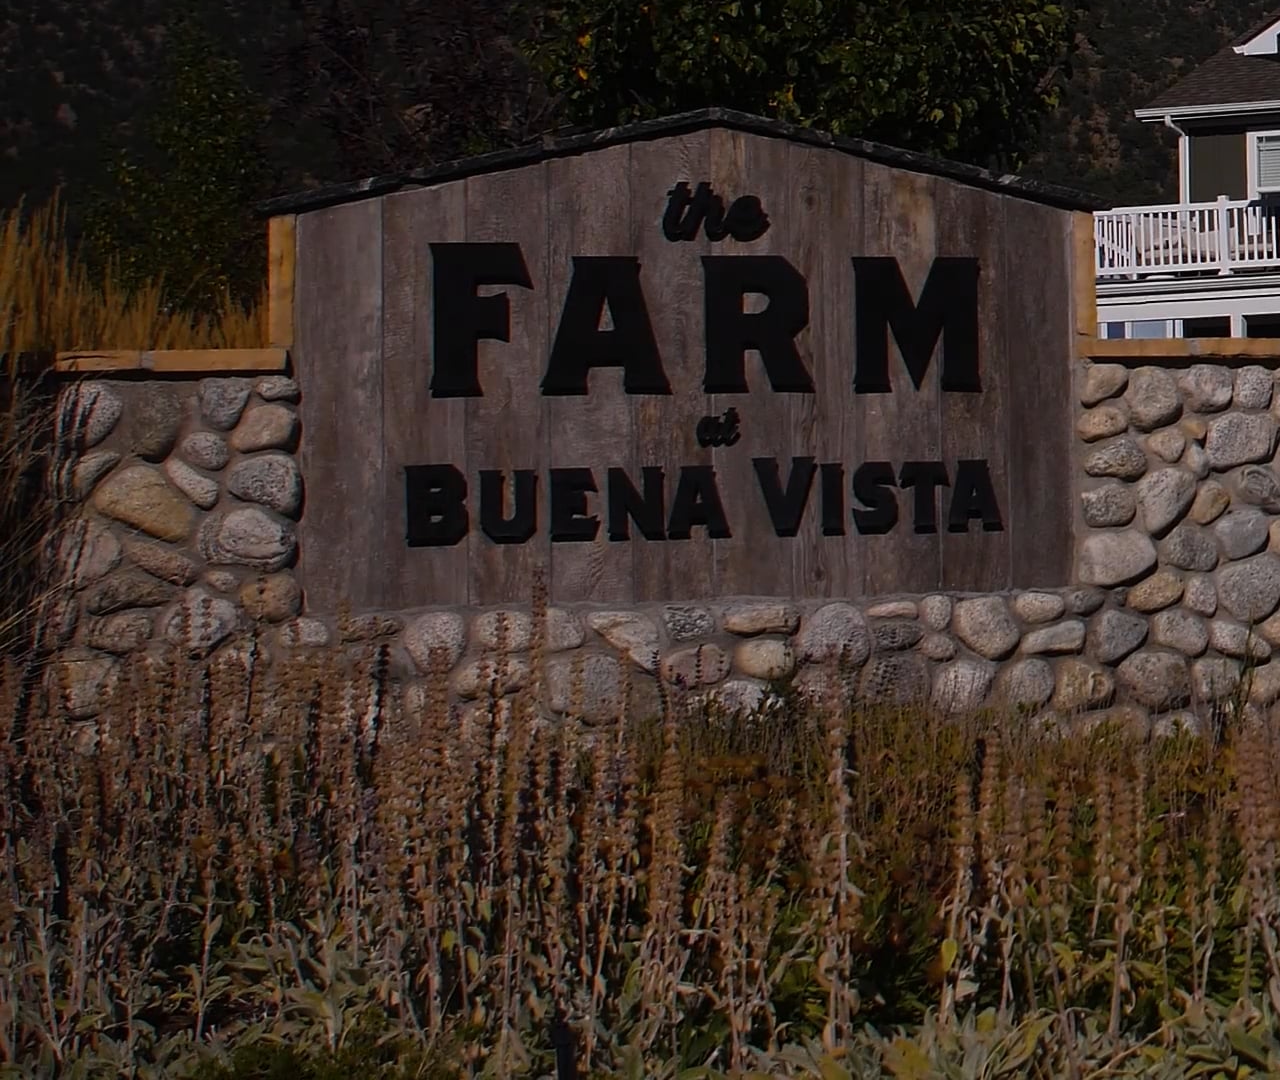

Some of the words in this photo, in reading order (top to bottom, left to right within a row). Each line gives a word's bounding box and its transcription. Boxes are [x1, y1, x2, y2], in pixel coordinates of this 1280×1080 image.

[663, 181, 769, 241] the
[430, 242, 981, 397] FARM
[697, 407, 740, 448] at
[405, 464, 731, 547] BUENA
[753, 457, 1004, 537] VISTA
